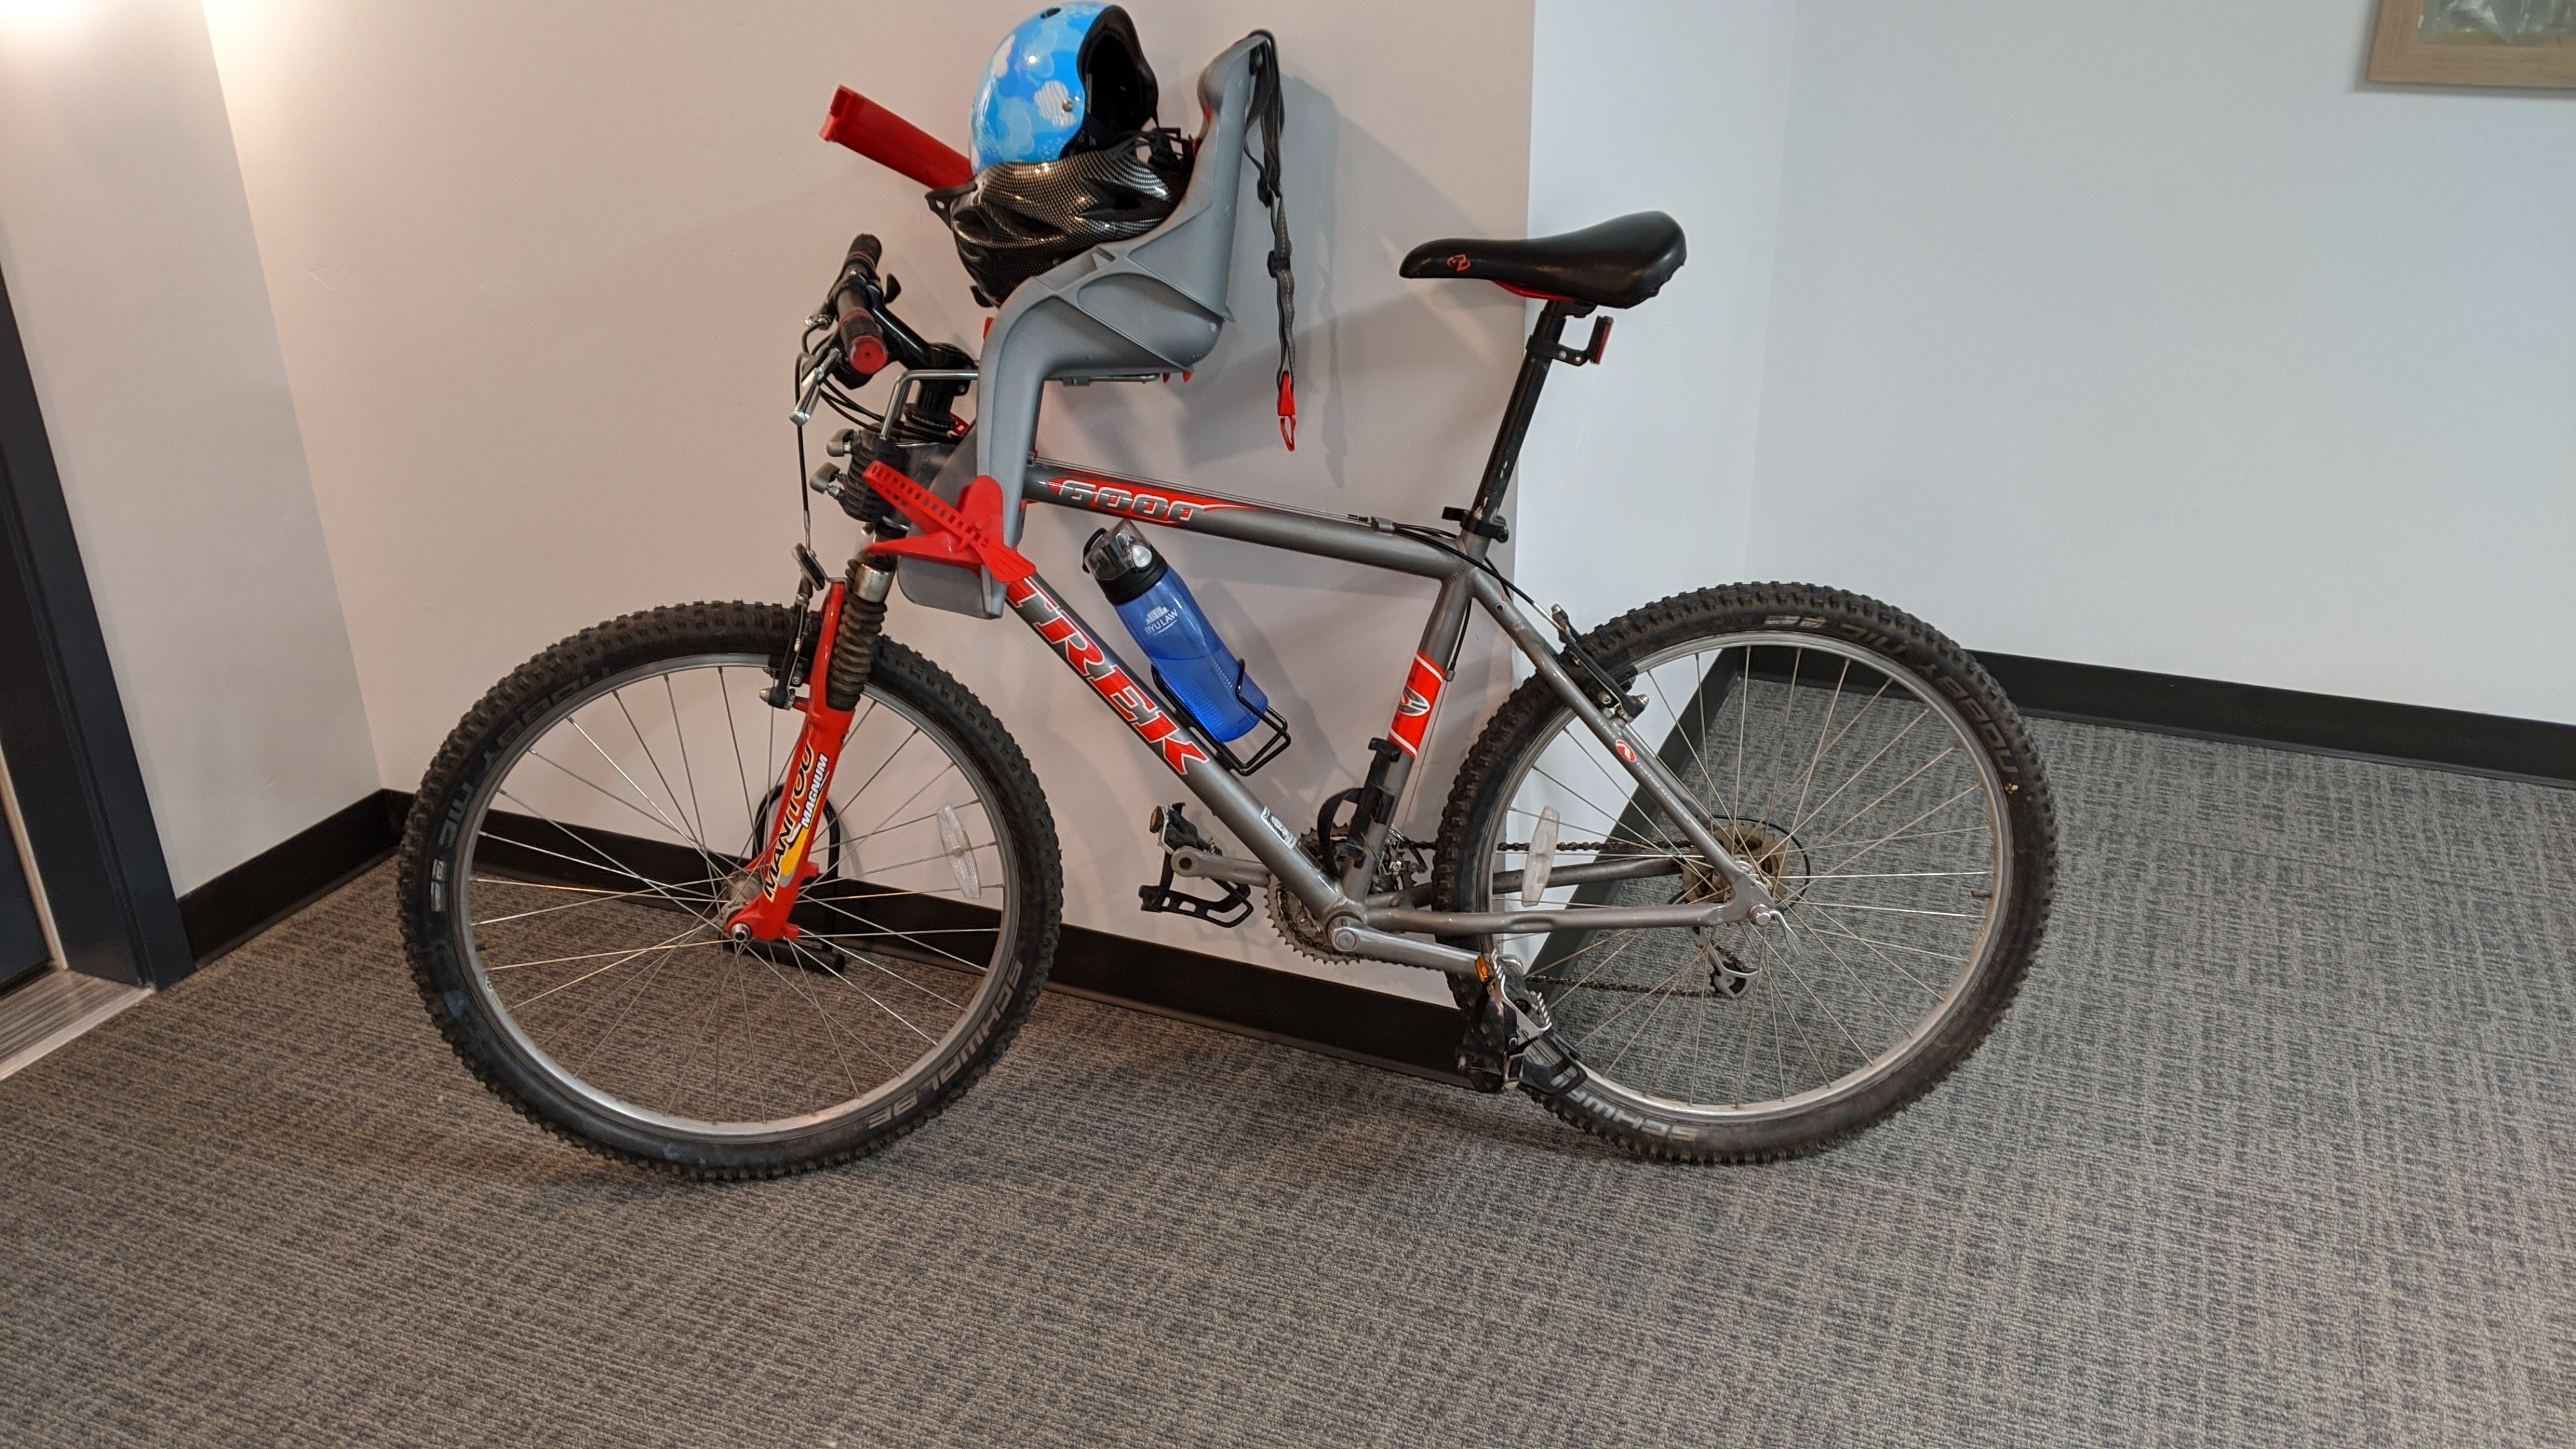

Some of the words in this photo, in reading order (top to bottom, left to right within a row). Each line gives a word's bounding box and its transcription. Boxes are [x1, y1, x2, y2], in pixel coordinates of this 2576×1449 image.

[1059, 480, 1205, 523] 6000
[1005, 576, 1210, 775] TREK
[1144, 621, 1161, 635] BYU
[1159, 608, 1178, 627] LAW
[762, 741, 814, 903] MANITOU
[800, 752, 829, 829] MAGNUM
[868, 959, 1024, 1130] SCHWALBE
